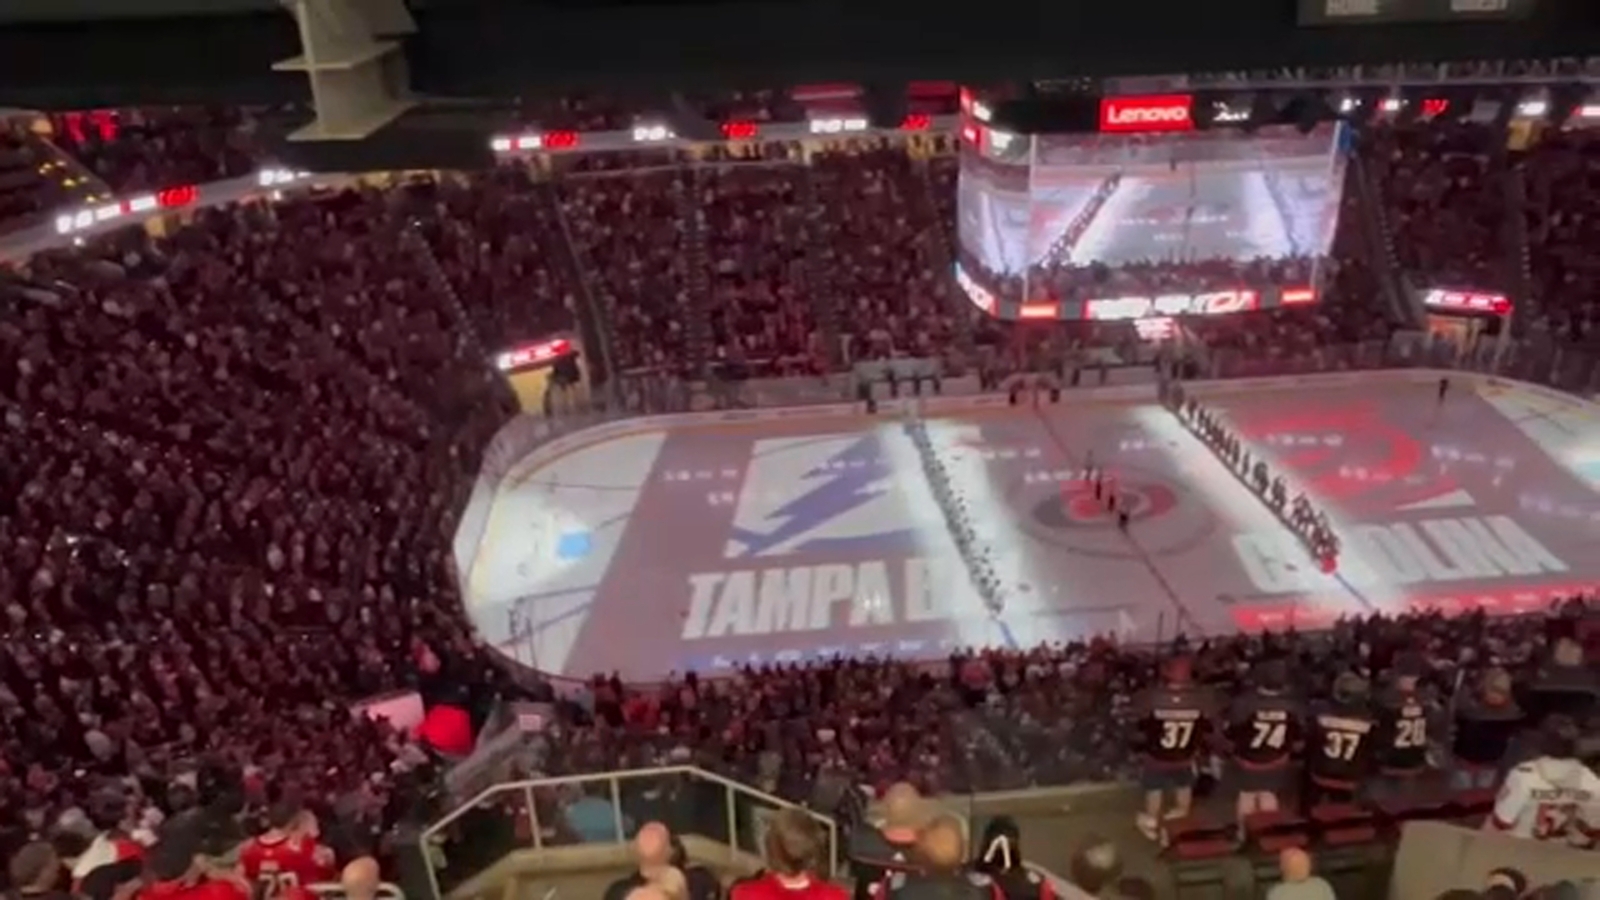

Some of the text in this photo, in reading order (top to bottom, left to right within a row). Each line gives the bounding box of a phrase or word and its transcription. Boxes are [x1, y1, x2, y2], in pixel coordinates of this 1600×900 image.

[1107, 104, 1188, 124] Lenovo
[681, 560, 894, 639] TAMPA
[1160, 721, 1194, 749] 37
[1250, 721, 1287, 749] 74
[1323, 732, 1360, 760] 37
